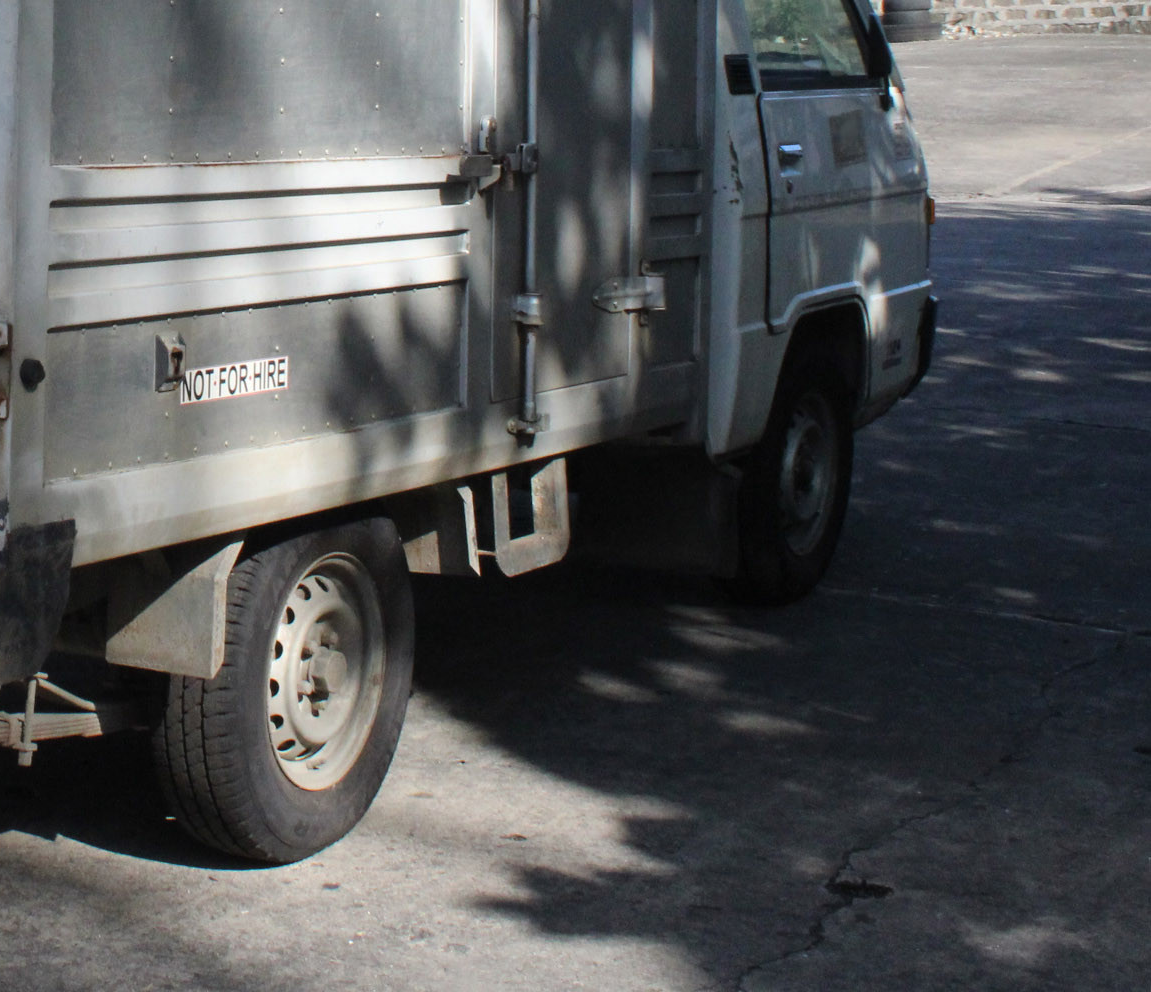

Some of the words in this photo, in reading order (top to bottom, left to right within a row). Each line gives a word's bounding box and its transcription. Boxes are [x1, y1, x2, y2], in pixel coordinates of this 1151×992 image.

[182, 369, 215, 403] NOT
[218, 363, 248, 397] FOR
[253, 358, 286, 392] HIRE
